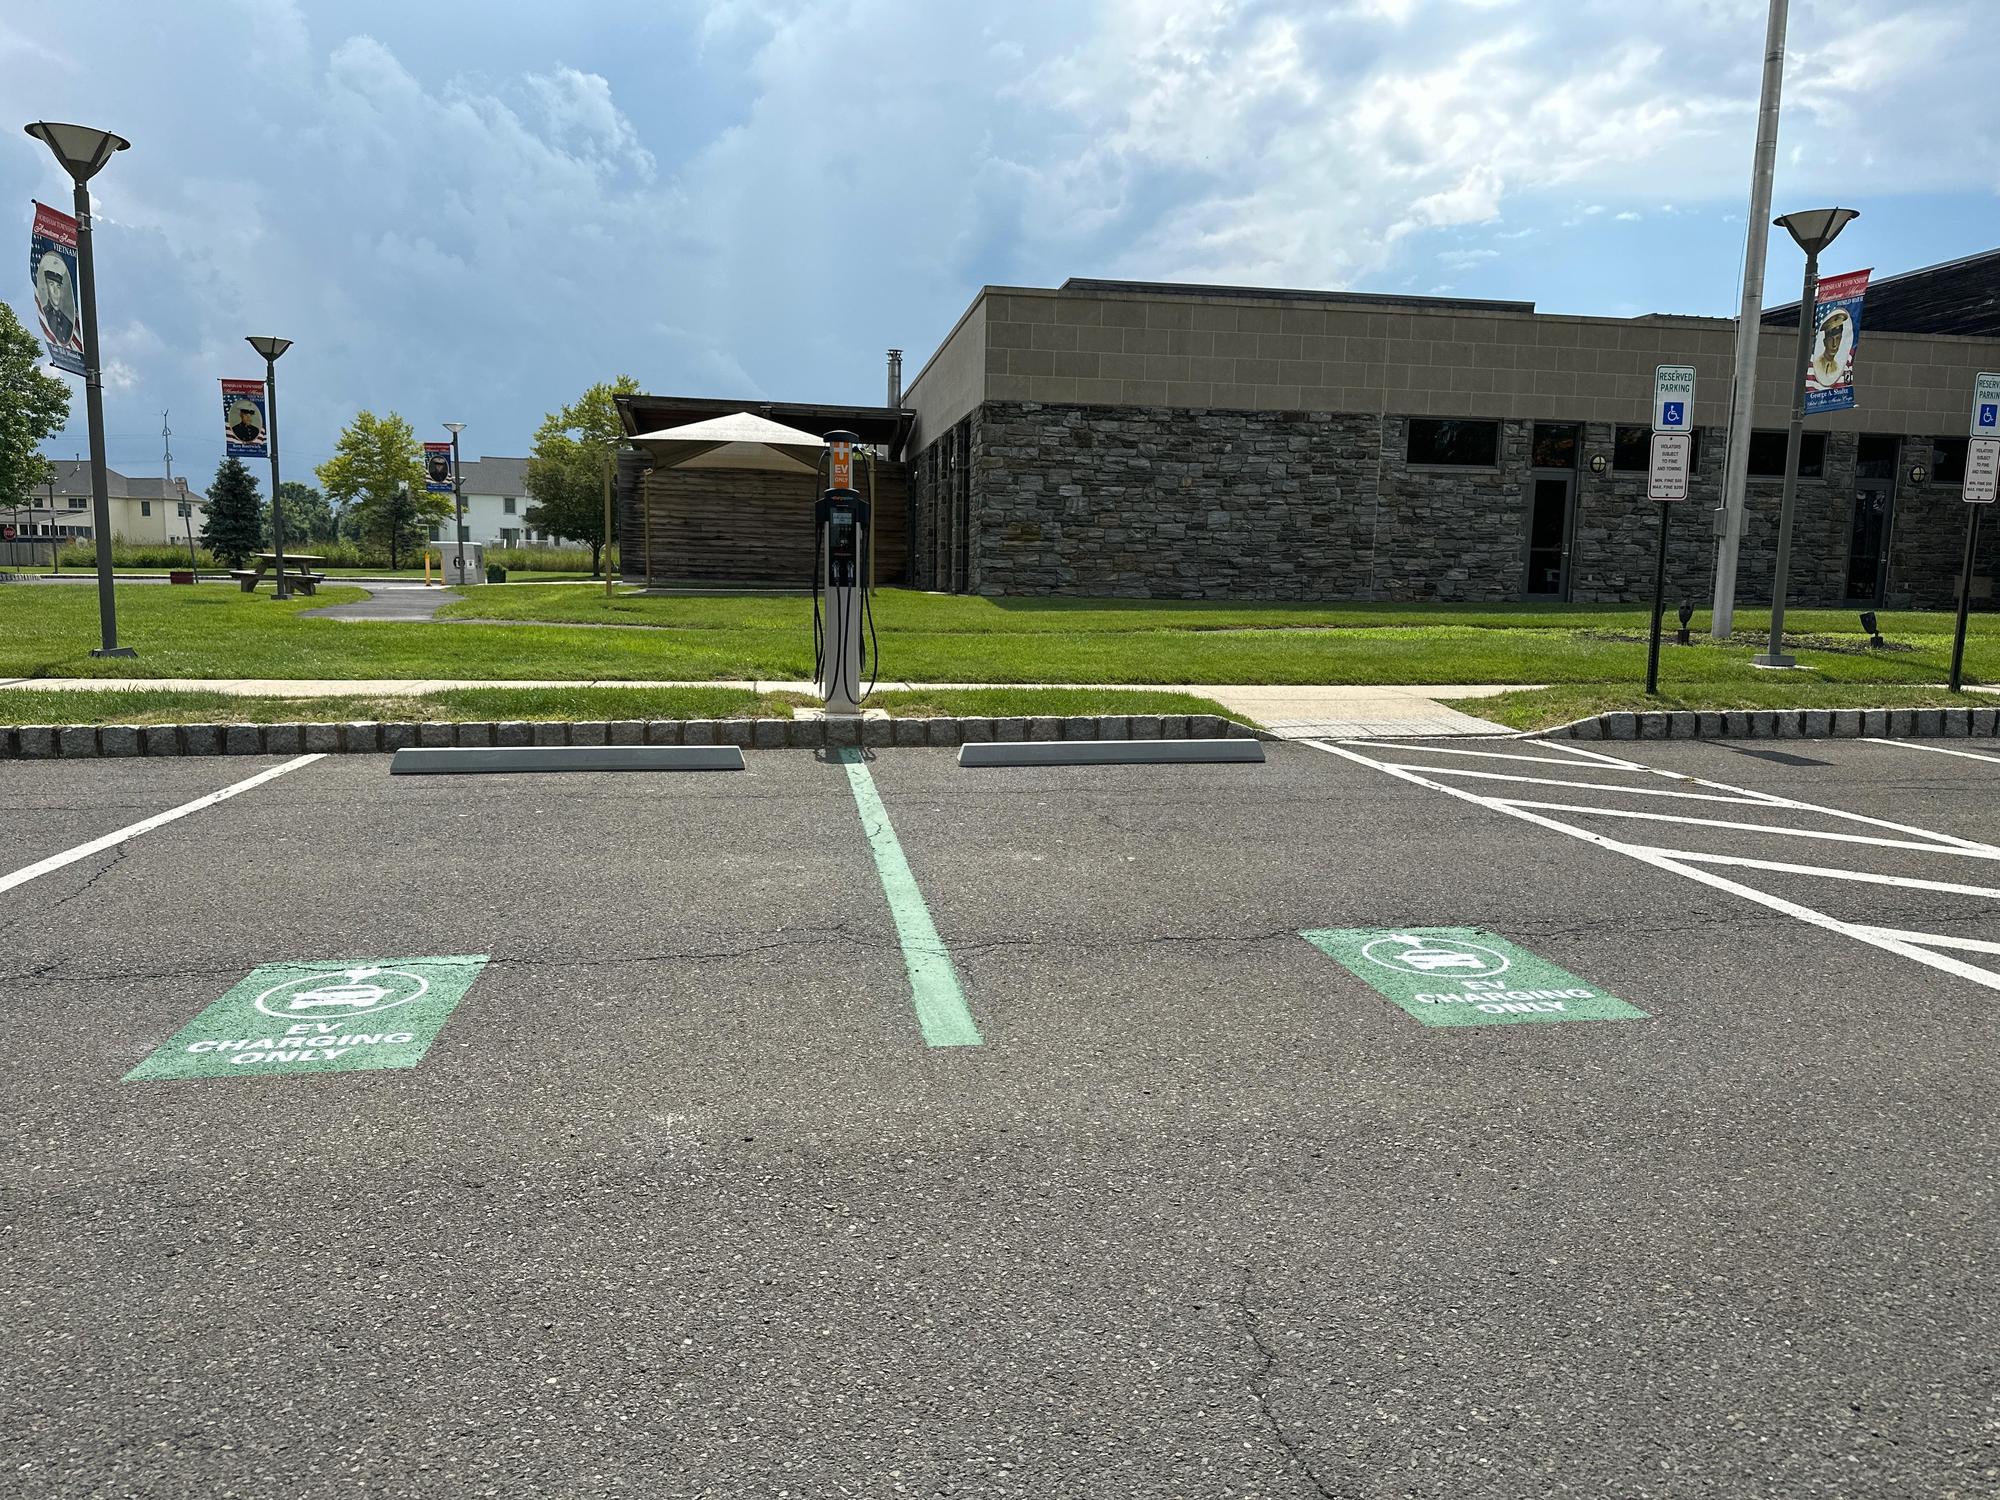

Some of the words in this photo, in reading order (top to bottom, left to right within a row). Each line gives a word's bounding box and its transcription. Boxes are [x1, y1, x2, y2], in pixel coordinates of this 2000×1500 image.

[53, 243, 77, 257] VIETNAM
[1660, 372, 1692, 381] RESERVED
[1660, 384, 1690, 392] PARKING
[1810, 391, 1827, 399] George
[835, 464, 848, 473] EV
[1461, 981, 1506, 990] EV
[1414, 989, 1596, 1004] CHARGING
[1477, 1001, 1567, 1013] ONLY
[285, 1023, 345, 1036] EV
[187, 1033, 415, 1053] CHARGING
[230, 1048, 352, 1064] ONLY
